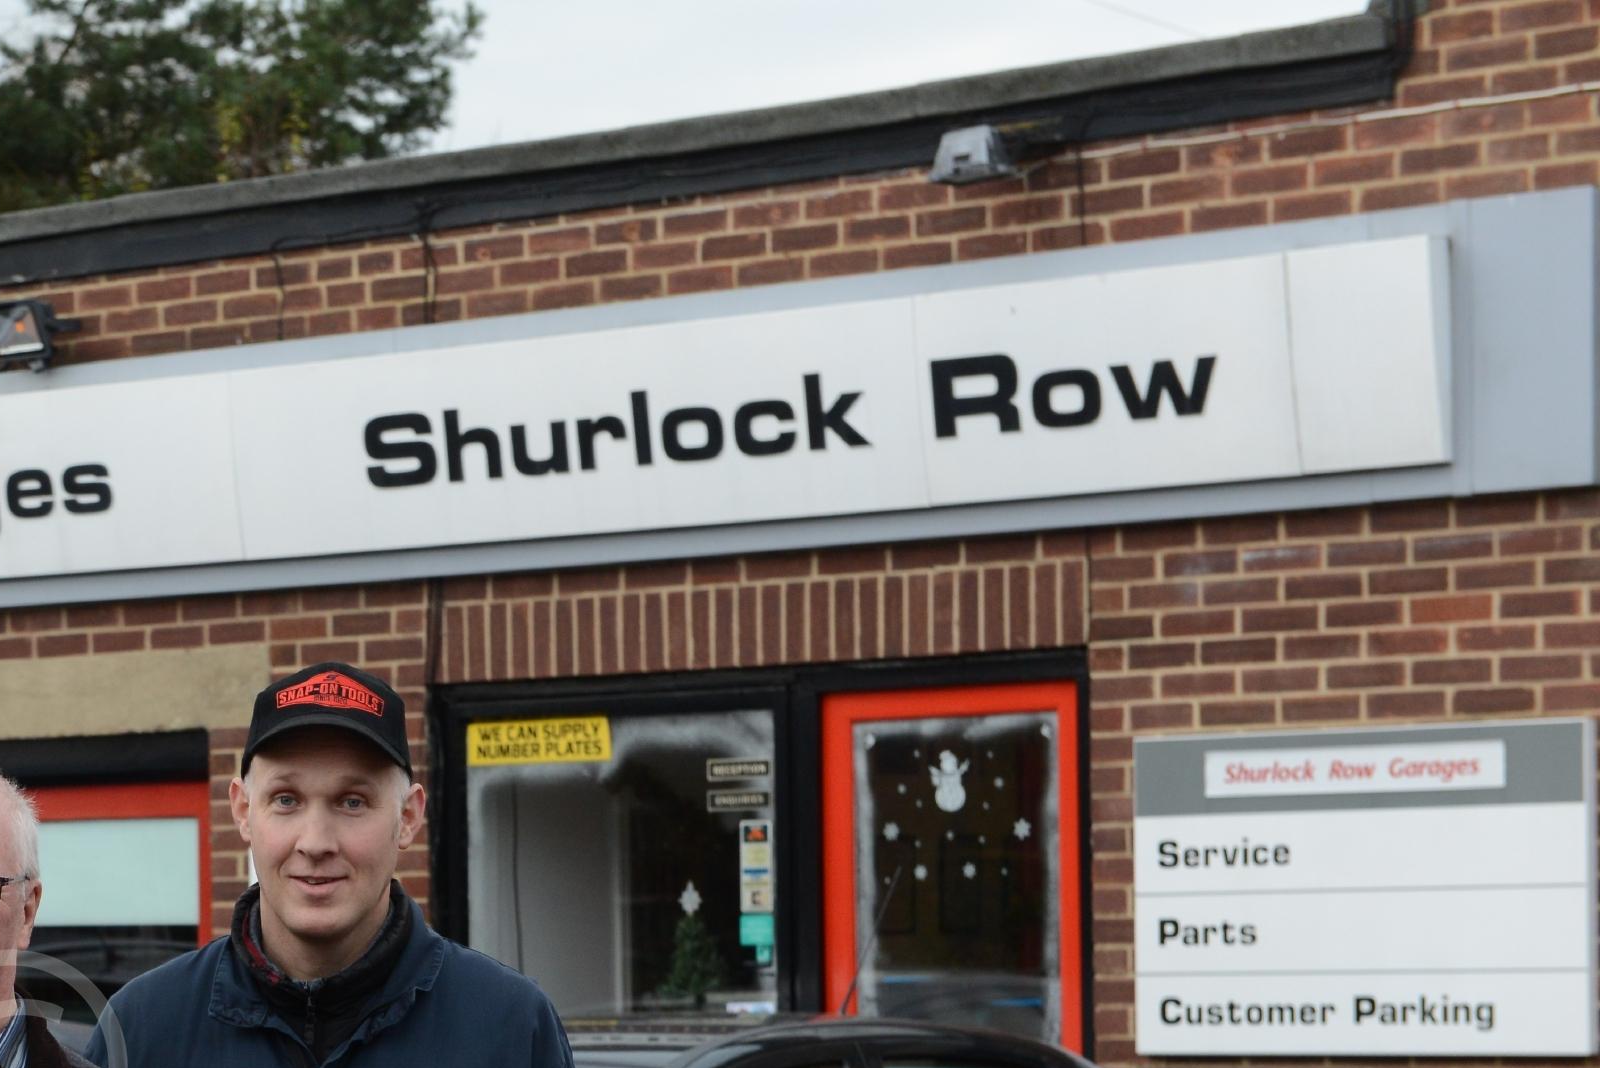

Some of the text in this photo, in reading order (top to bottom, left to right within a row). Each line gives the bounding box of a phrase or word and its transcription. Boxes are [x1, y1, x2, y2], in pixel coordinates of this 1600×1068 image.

[362, 352, 1218, 489] Shurlock Row
[279, 683, 379, 712] SNAP-ON TOOLS
[478, 722, 601, 741] WE CAN SUPPLY
[476, 741, 602, 759] NUMBER PLATES
[1224, 757, 1482, 785] Shurlock Row Garages
[1157, 838, 1291, 868] Service
[1158, 918, 1258, 946] Parts
[1159, 995, 1495, 1030] Customer Parking
